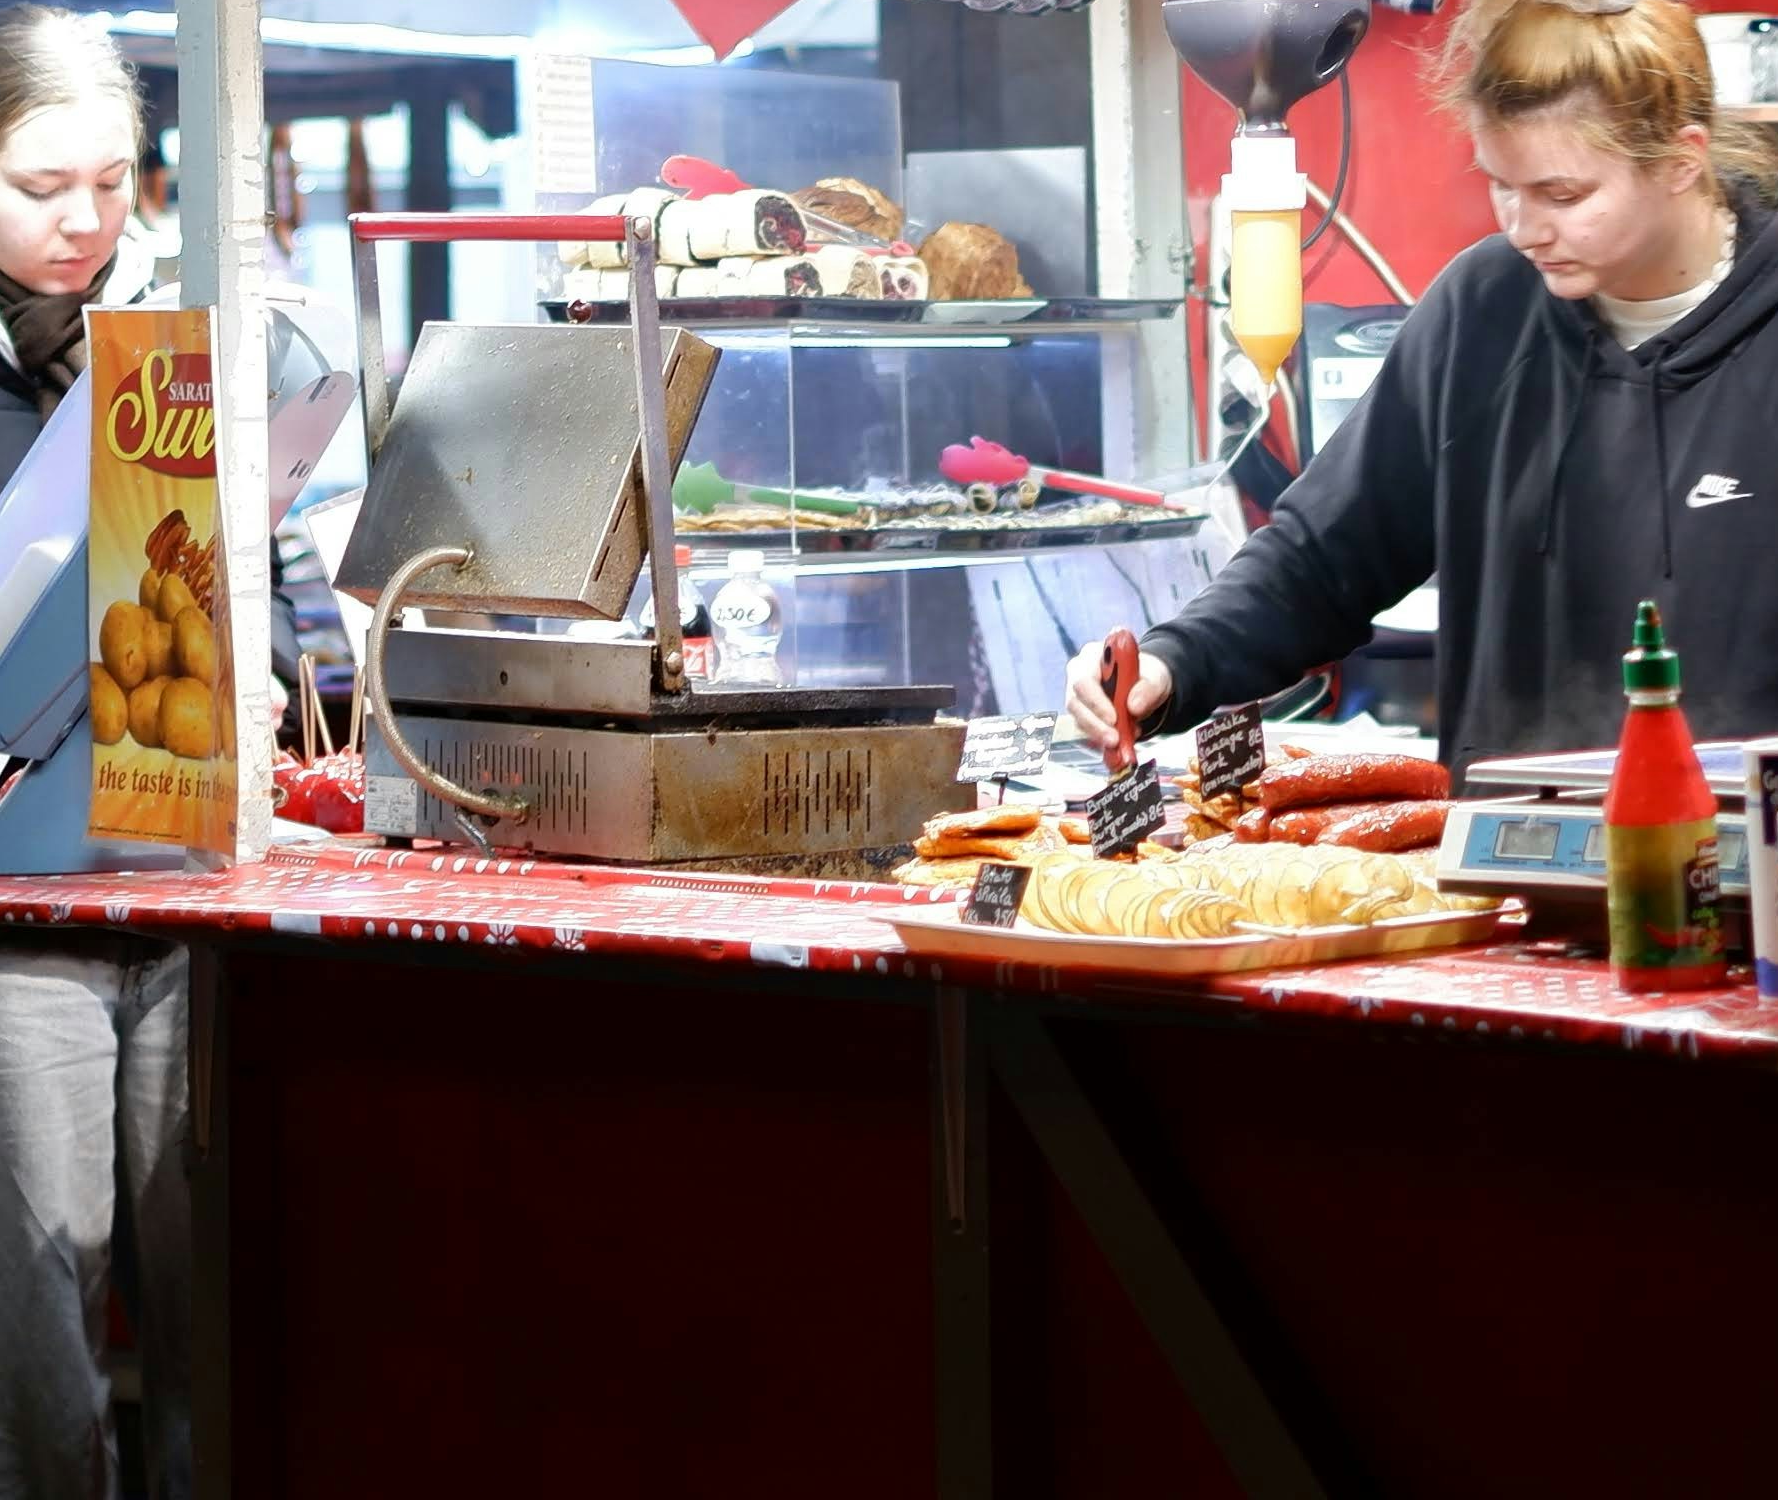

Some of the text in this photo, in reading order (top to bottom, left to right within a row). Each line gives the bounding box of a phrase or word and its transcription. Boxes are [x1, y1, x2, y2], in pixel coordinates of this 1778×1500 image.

[168, 381, 215, 402] SARAT
[99, 761, 127, 790] the
[131, 767, 173, 794] taste
[178, 769, 192, 797] is
[195, 771, 210, 799] in
